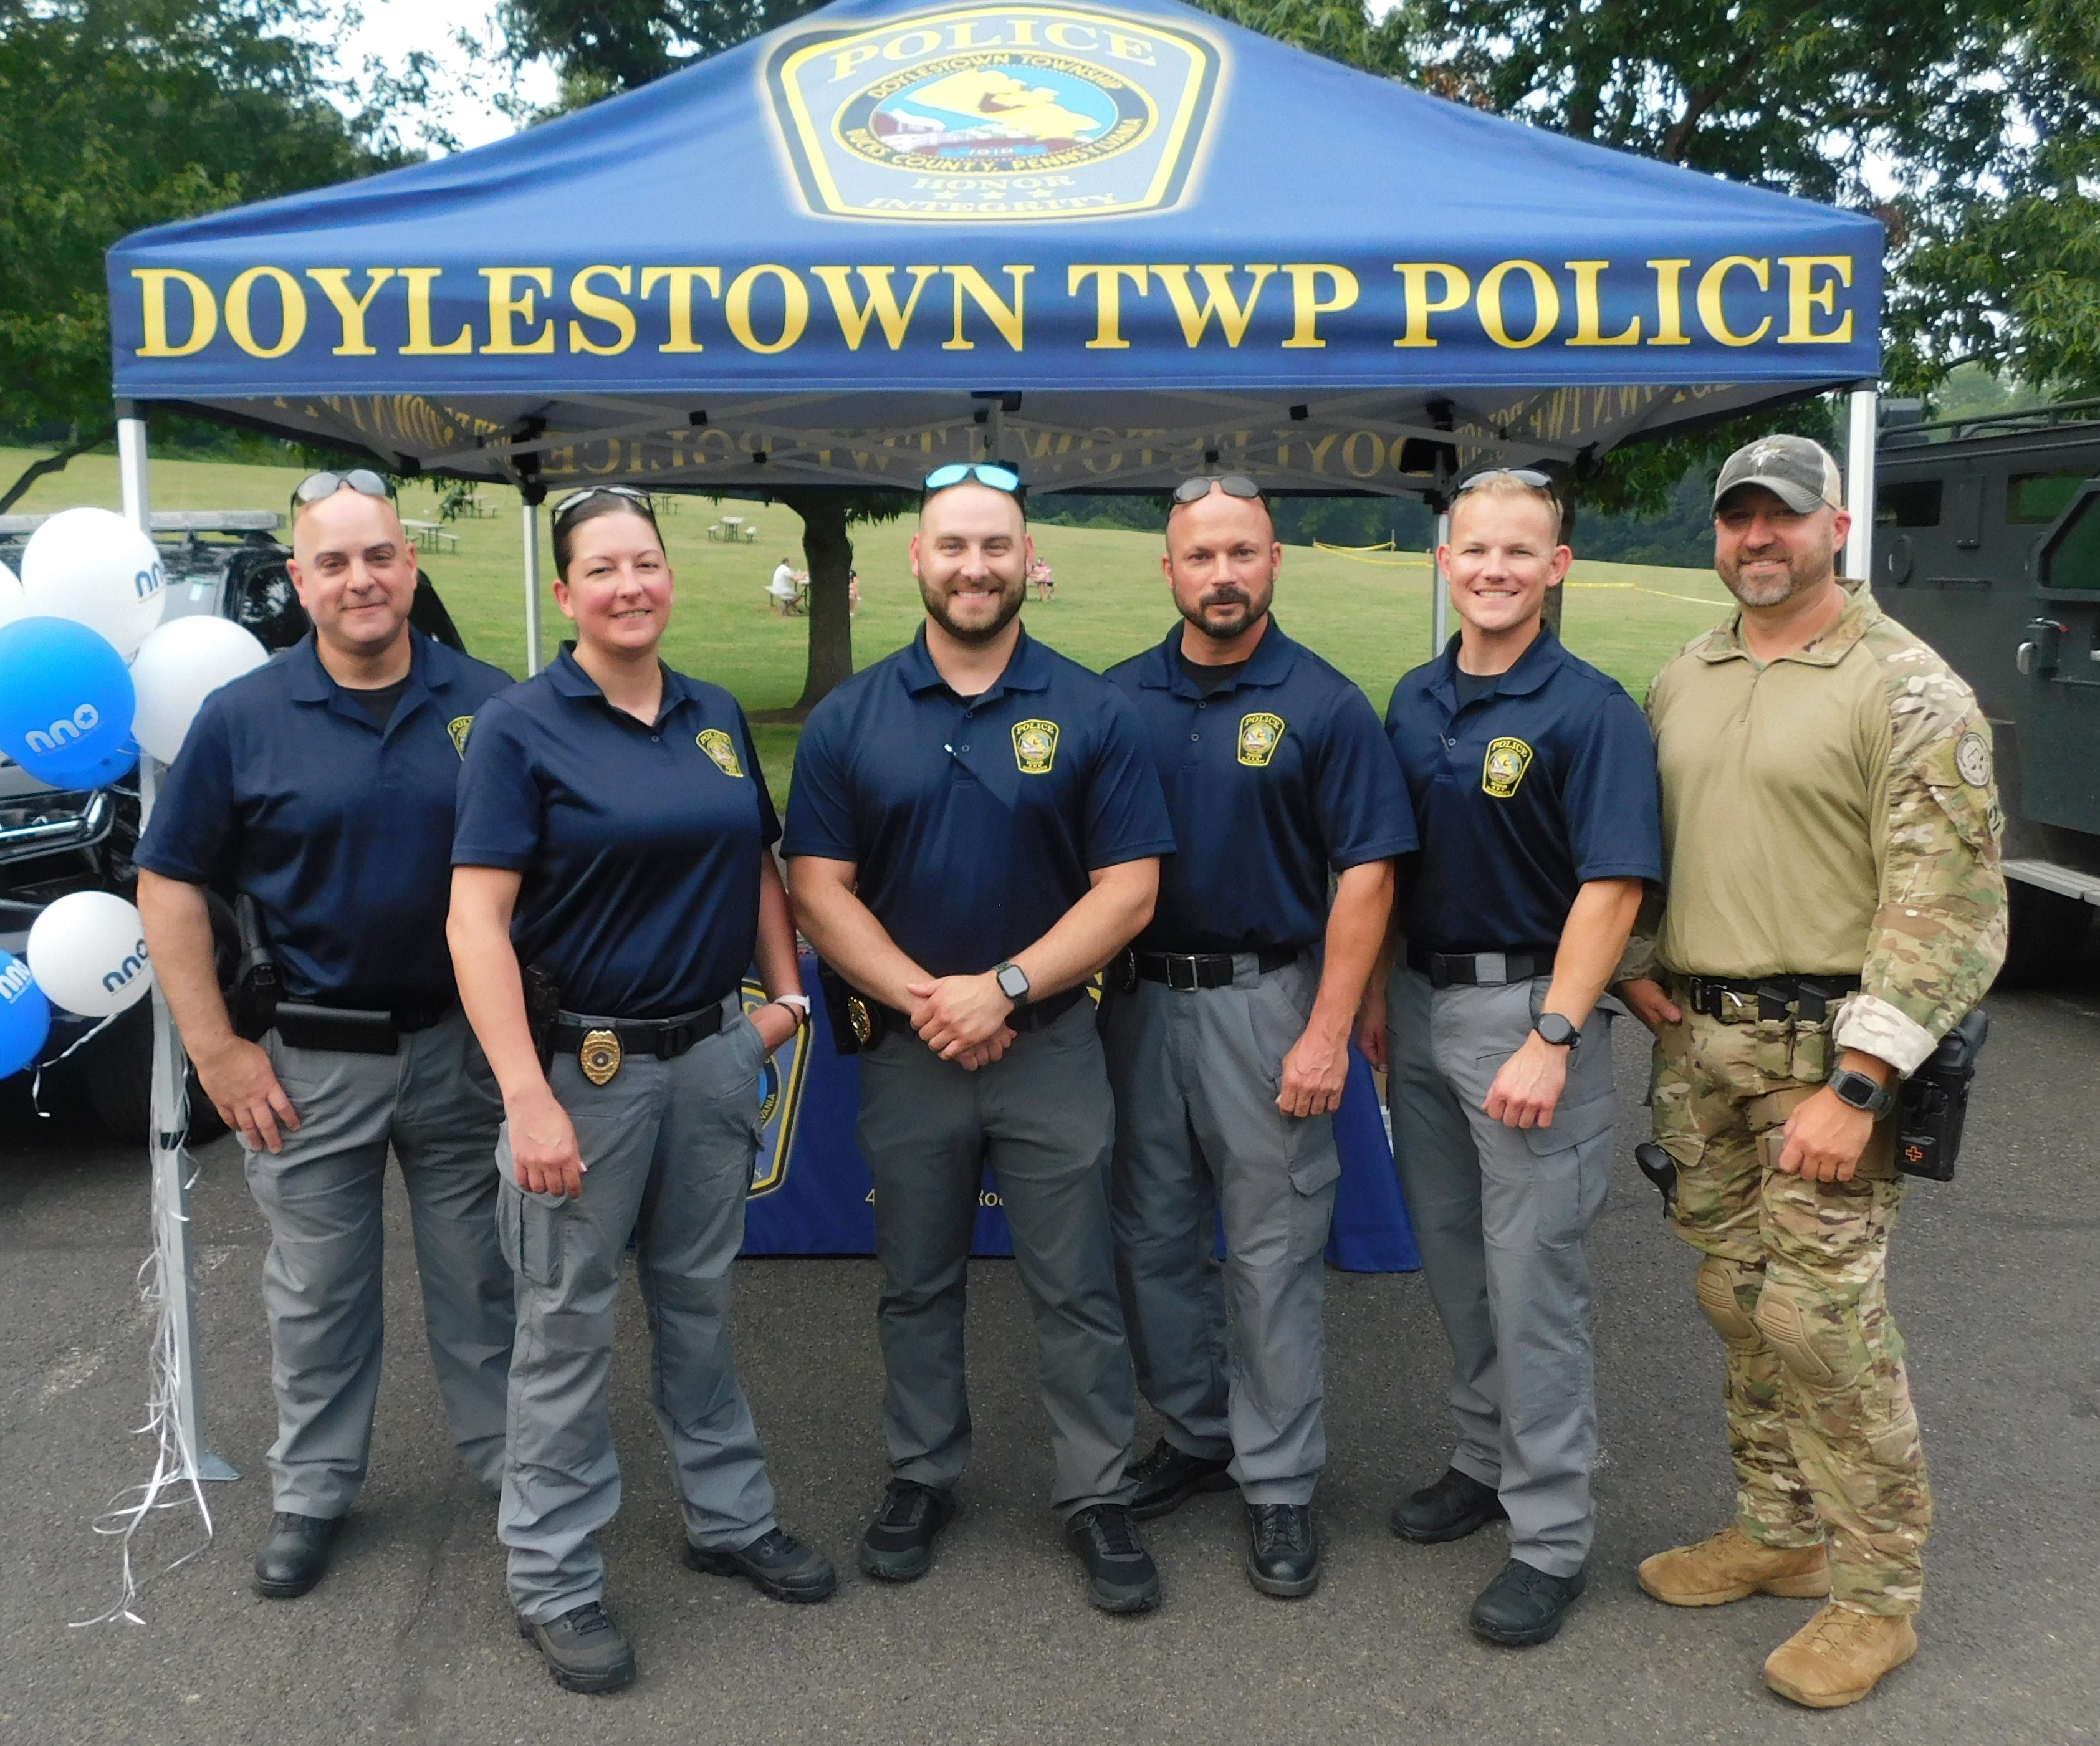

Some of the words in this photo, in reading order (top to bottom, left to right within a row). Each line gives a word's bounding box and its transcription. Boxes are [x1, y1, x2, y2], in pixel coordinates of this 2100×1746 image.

[827, 19, 1156, 84] POLICE
[867, 54, 1010, 98] DOYLESTOWN
[1022, 54, 1123, 89] TOWNSHIP
[1012, 118, 1144, 171] PENNSYLVANIA
[912, 175, 1076, 189] HONOR
[865, 193, 1118, 211] INTEGRITY
[131, 263, 1035, 360] DOYLESTOWN
[1068, 262, 1359, 349] TWP
[1393, 256, 1853, 350] POLICE
[1016, 722, 1055, 734] POLICE
[1244, 716, 1280, 729] POLICE
[1492, 741, 1528, 758] POLICE
